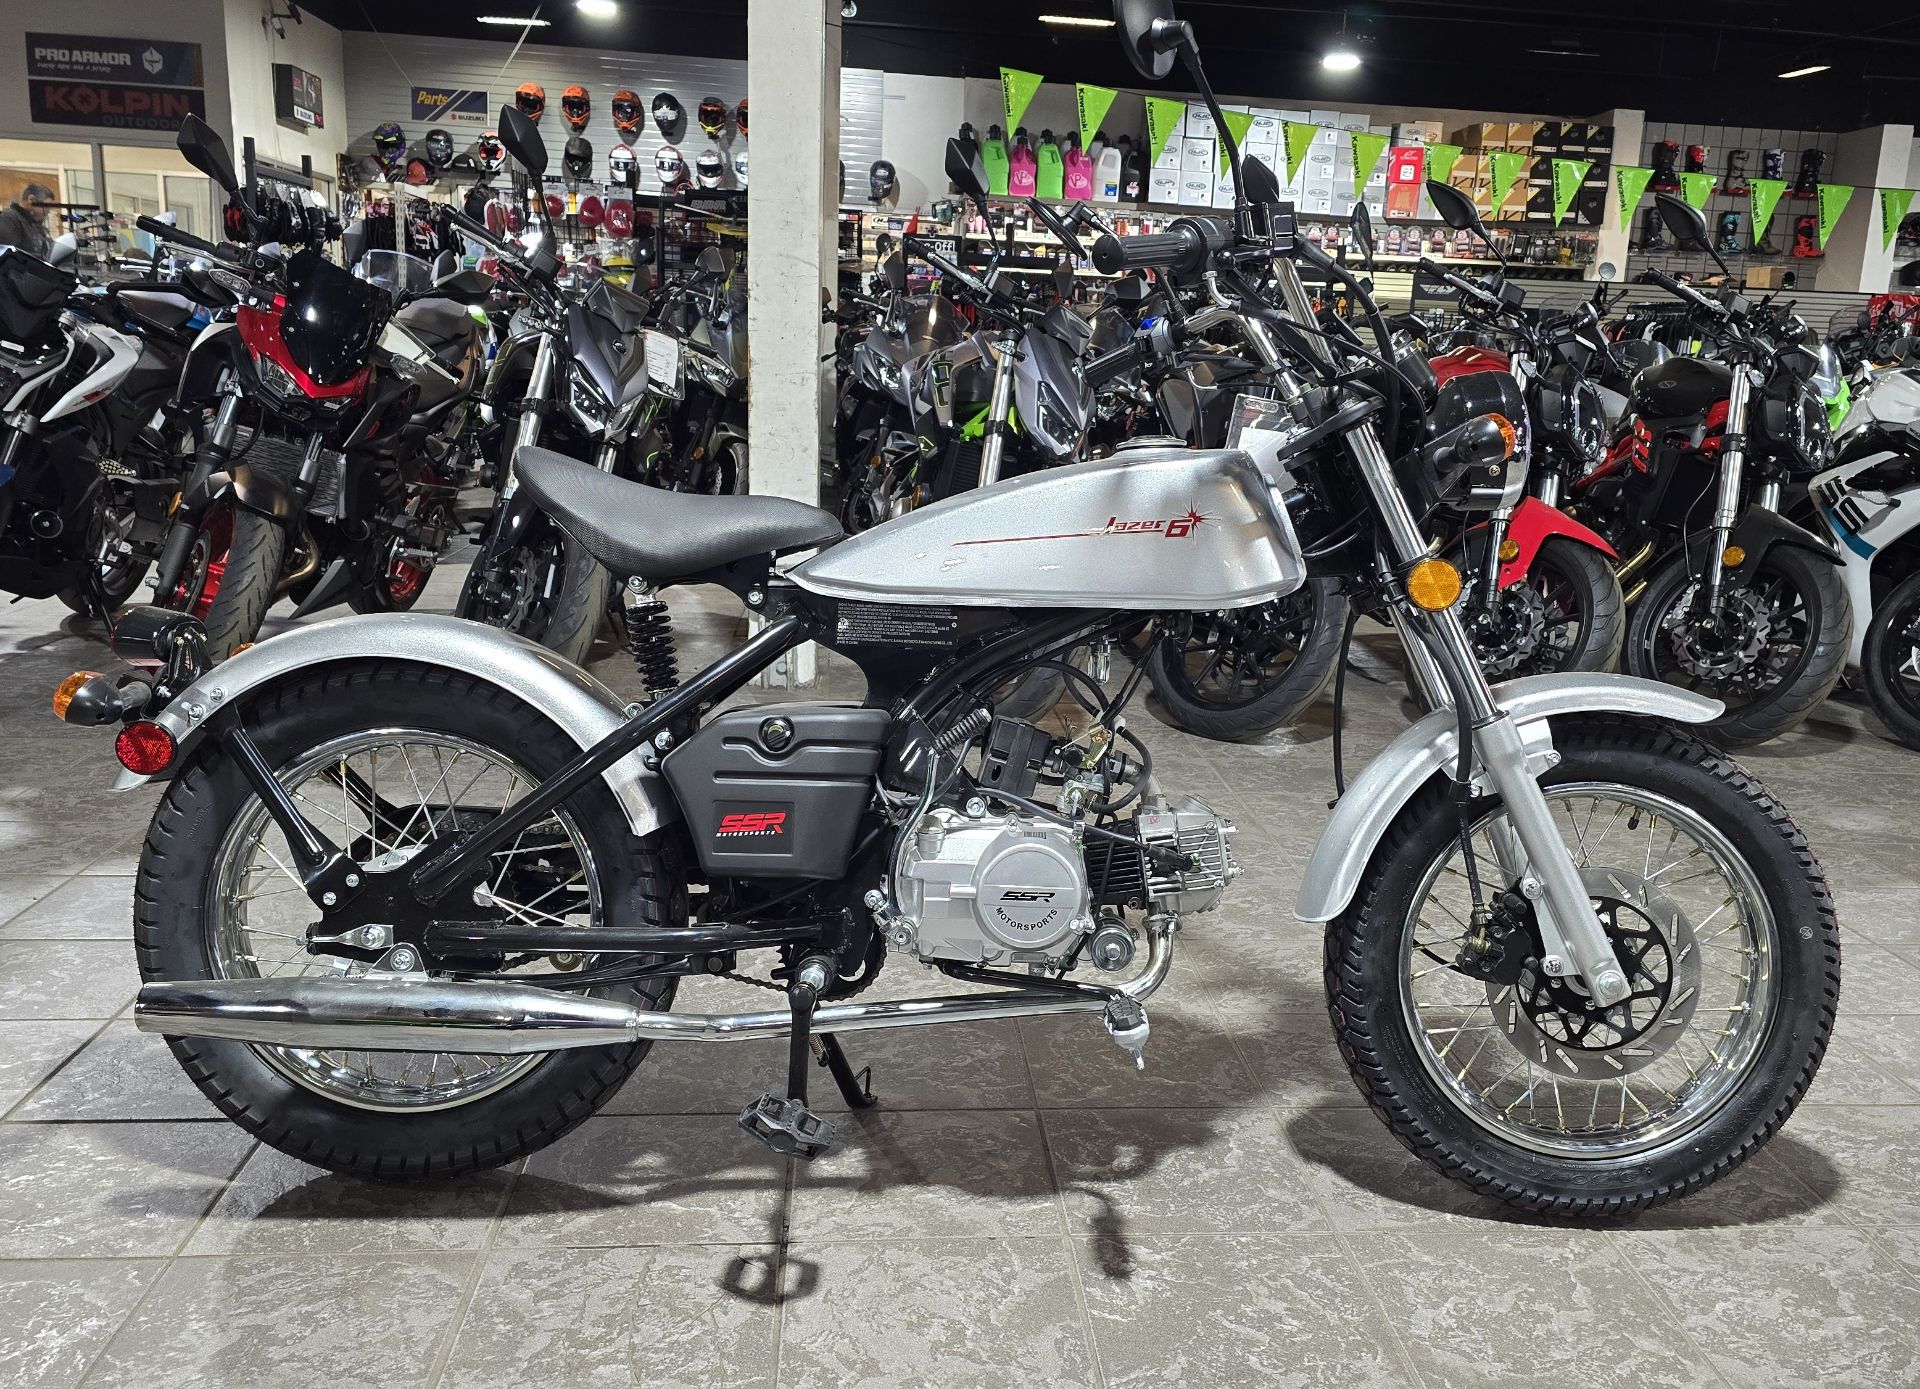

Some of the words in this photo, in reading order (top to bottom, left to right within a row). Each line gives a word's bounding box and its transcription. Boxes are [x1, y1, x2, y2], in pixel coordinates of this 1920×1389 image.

[34, 48, 69, 61] PRO
[71, 50, 132, 66] ARMOR
[44, 84, 190, 117] KOLPIN
[417, 91, 448, 106] Parts
[1078, 87, 1088, 132] Kawasaki
[1147, 101, 1158, 145] Kawasaki
[1283, 121, 1293, 164] Kawasaki
[1352, 136, 1361, 178] Kawasaki
[1489, 155, 1499, 198] Kawasaki
[1553, 162, 1563, 204] Kawasaki
[1616, 170, 1628, 211] Kawasaki
[1751, 182, 1762, 224] Kawasaki
[1819, 188, 1827, 229] Kawasaki
[1881, 193, 1889, 233] Kawasaki
[1165, 518, 1193, 538] 6
[718, 811, 786, 834] SSR
[1000, 891, 1055, 903] SSR
[996, 907, 1058, 931] MOTORSPORTS
